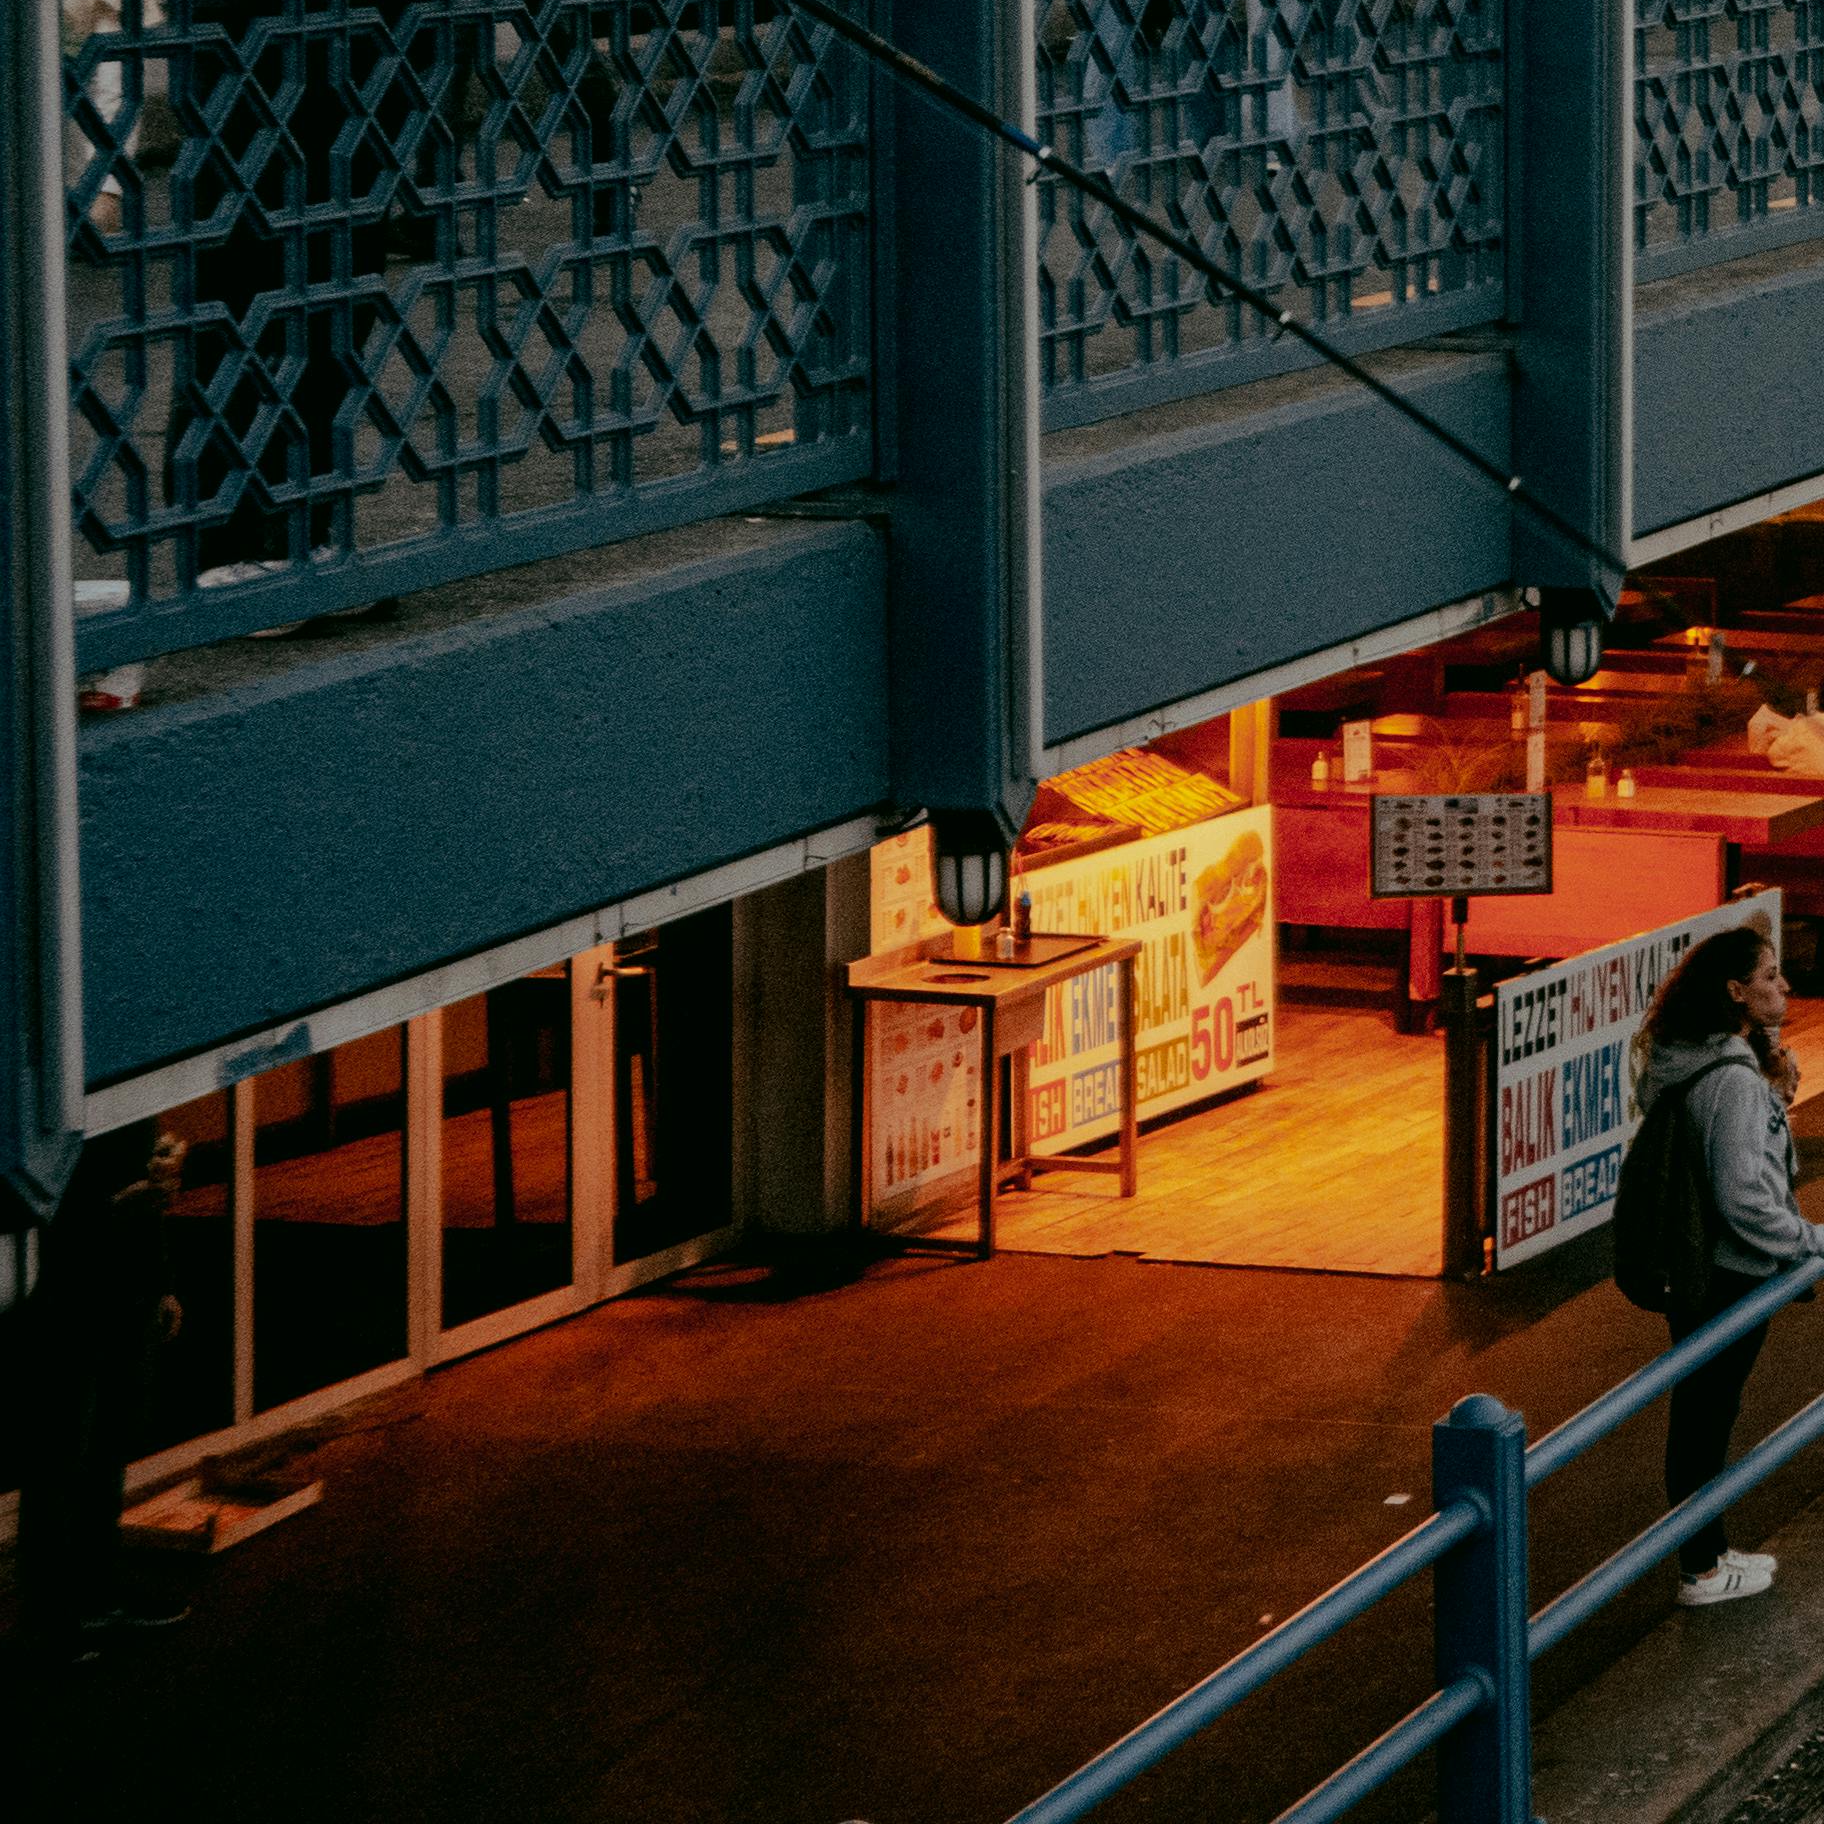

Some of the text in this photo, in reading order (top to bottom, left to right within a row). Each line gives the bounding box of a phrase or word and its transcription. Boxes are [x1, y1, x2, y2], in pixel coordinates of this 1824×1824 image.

[1071, 963, 1119, 1057] EKME
[1191, 996, 1234, 1081] 50
[1236, 980, 1265, 1013] TL
[1503, 978, 1567, 1066] LEZZET
[1031, 1082, 1065, 1142] ISH
[1072, 1062, 1120, 1130] BREA
[1136, 1040, 1189, 1105] SALAD
[1502, 1039, 1624, 1176] BALIK EKMEK
[1503, 1177, 1553, 1247] FISH
